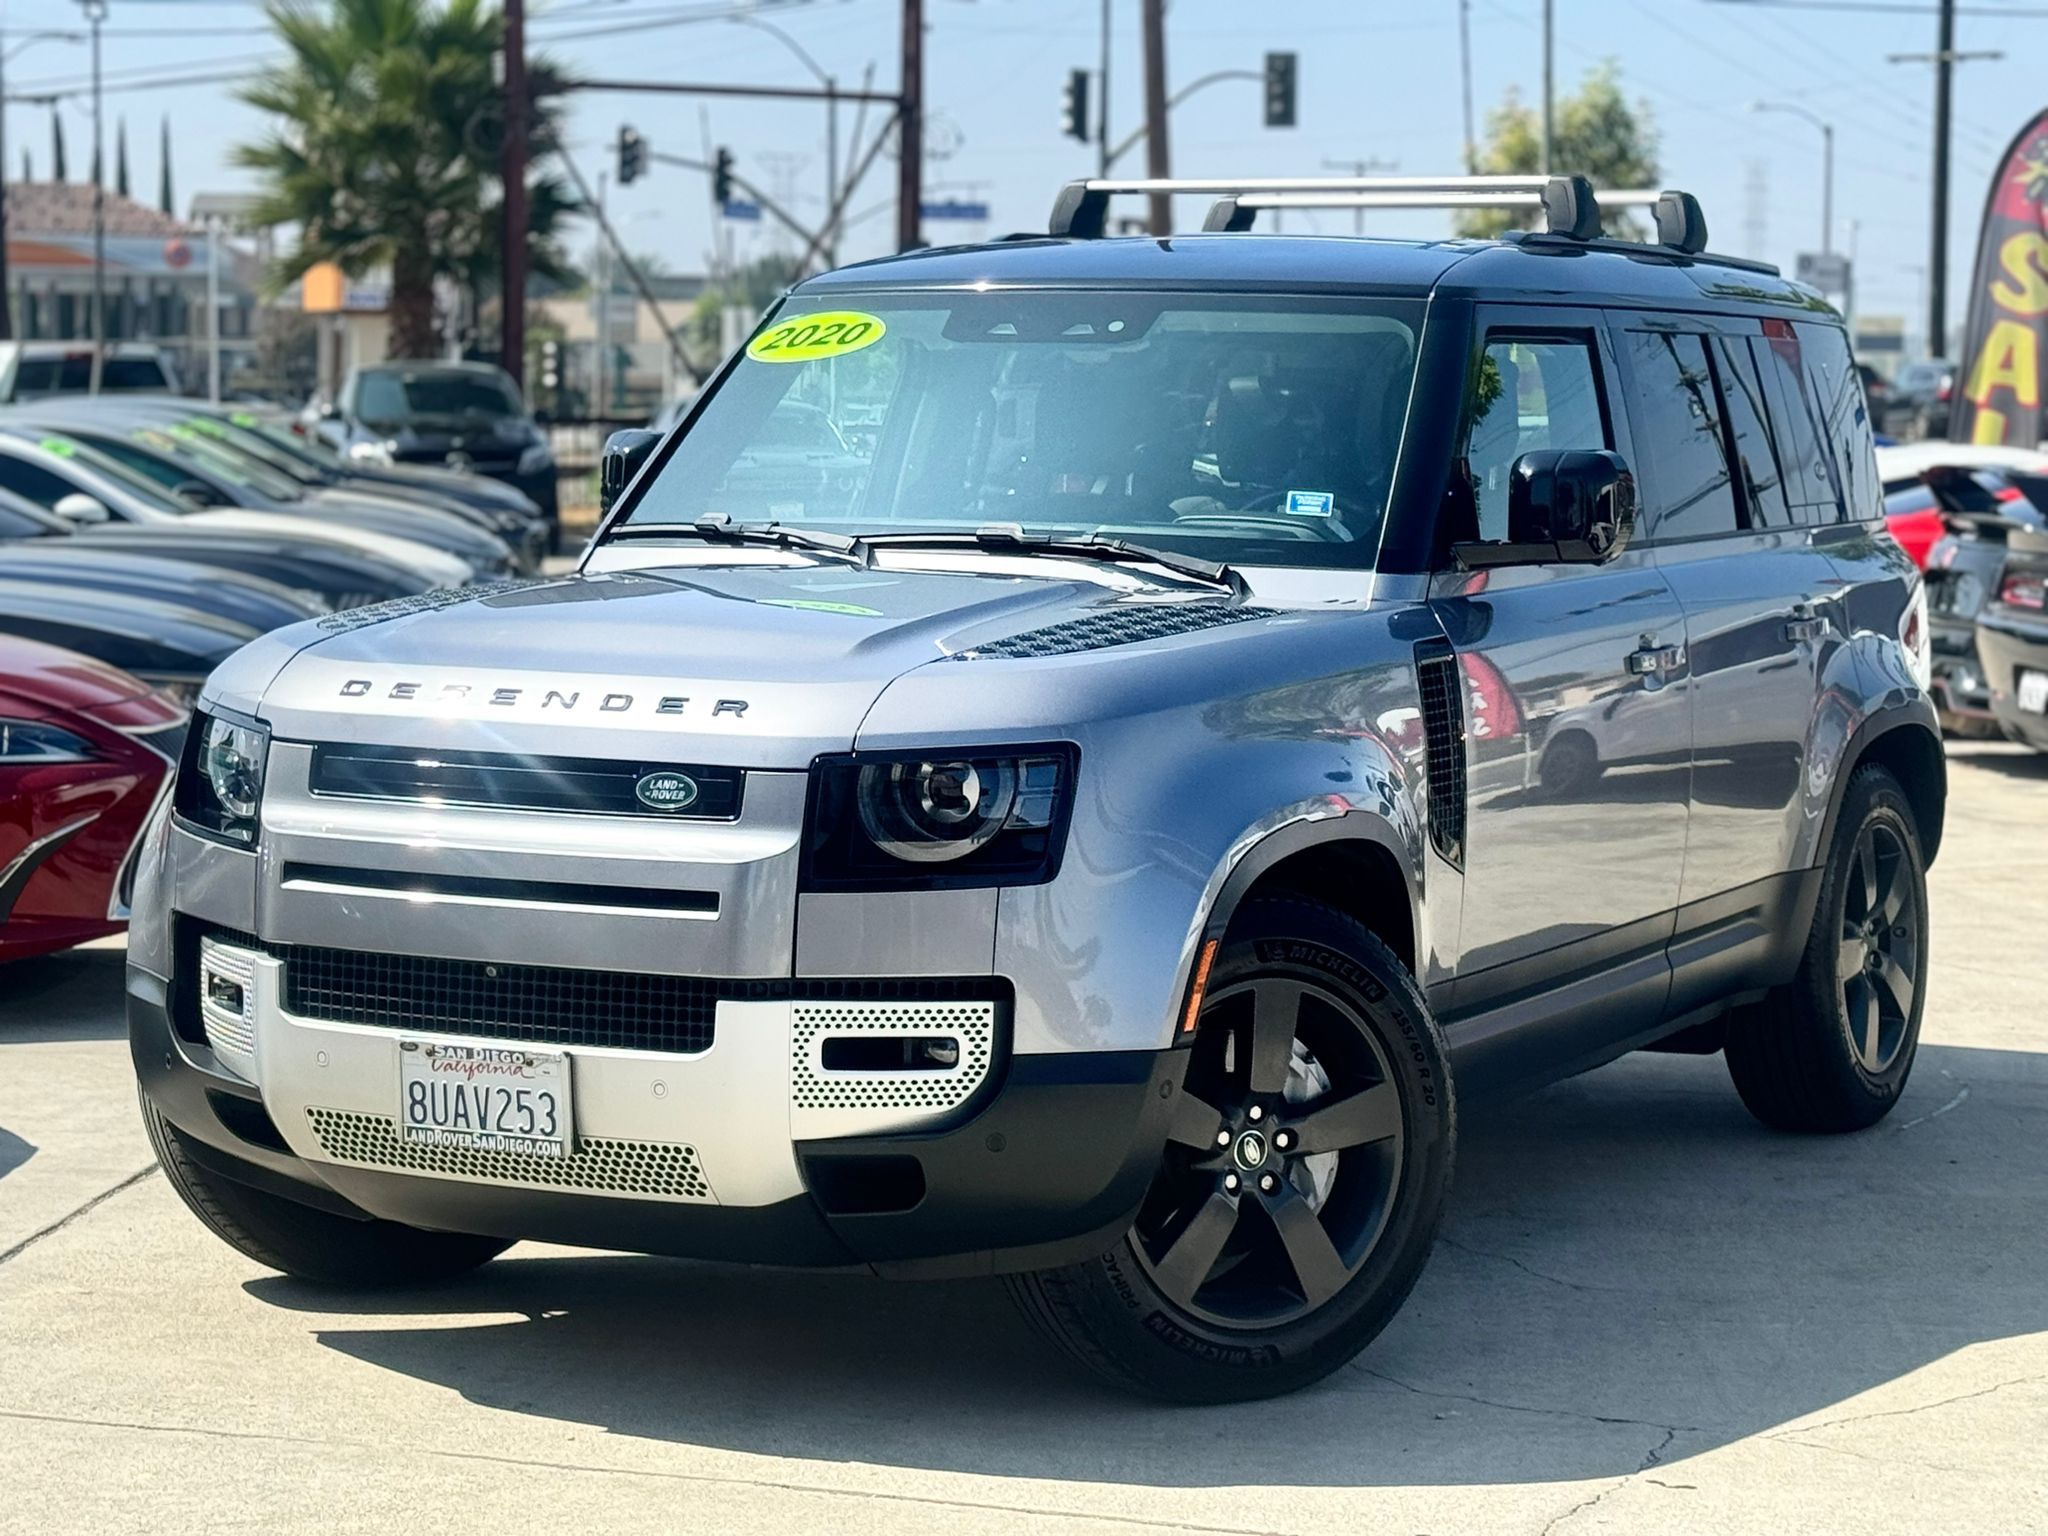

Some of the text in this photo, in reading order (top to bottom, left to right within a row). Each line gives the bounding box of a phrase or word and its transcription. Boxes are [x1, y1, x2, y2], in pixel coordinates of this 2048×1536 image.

[758, 322, 872, 352] 2020
[649, 779, 679, 790] LAND
[650, 789, 686, 800] ROVER
[1289, 944, 1383, 999] MICHELIN
[434, 1045, 467, 1061] SAN
[473, 1047, 526, 1064] DIEGO
[1391, 1008, 1436, 1107] 255/60 R 20
[408, 1080, 557, 1137] 8UAV253
[1102, 1252, 1141, 1309] PRIMAC
